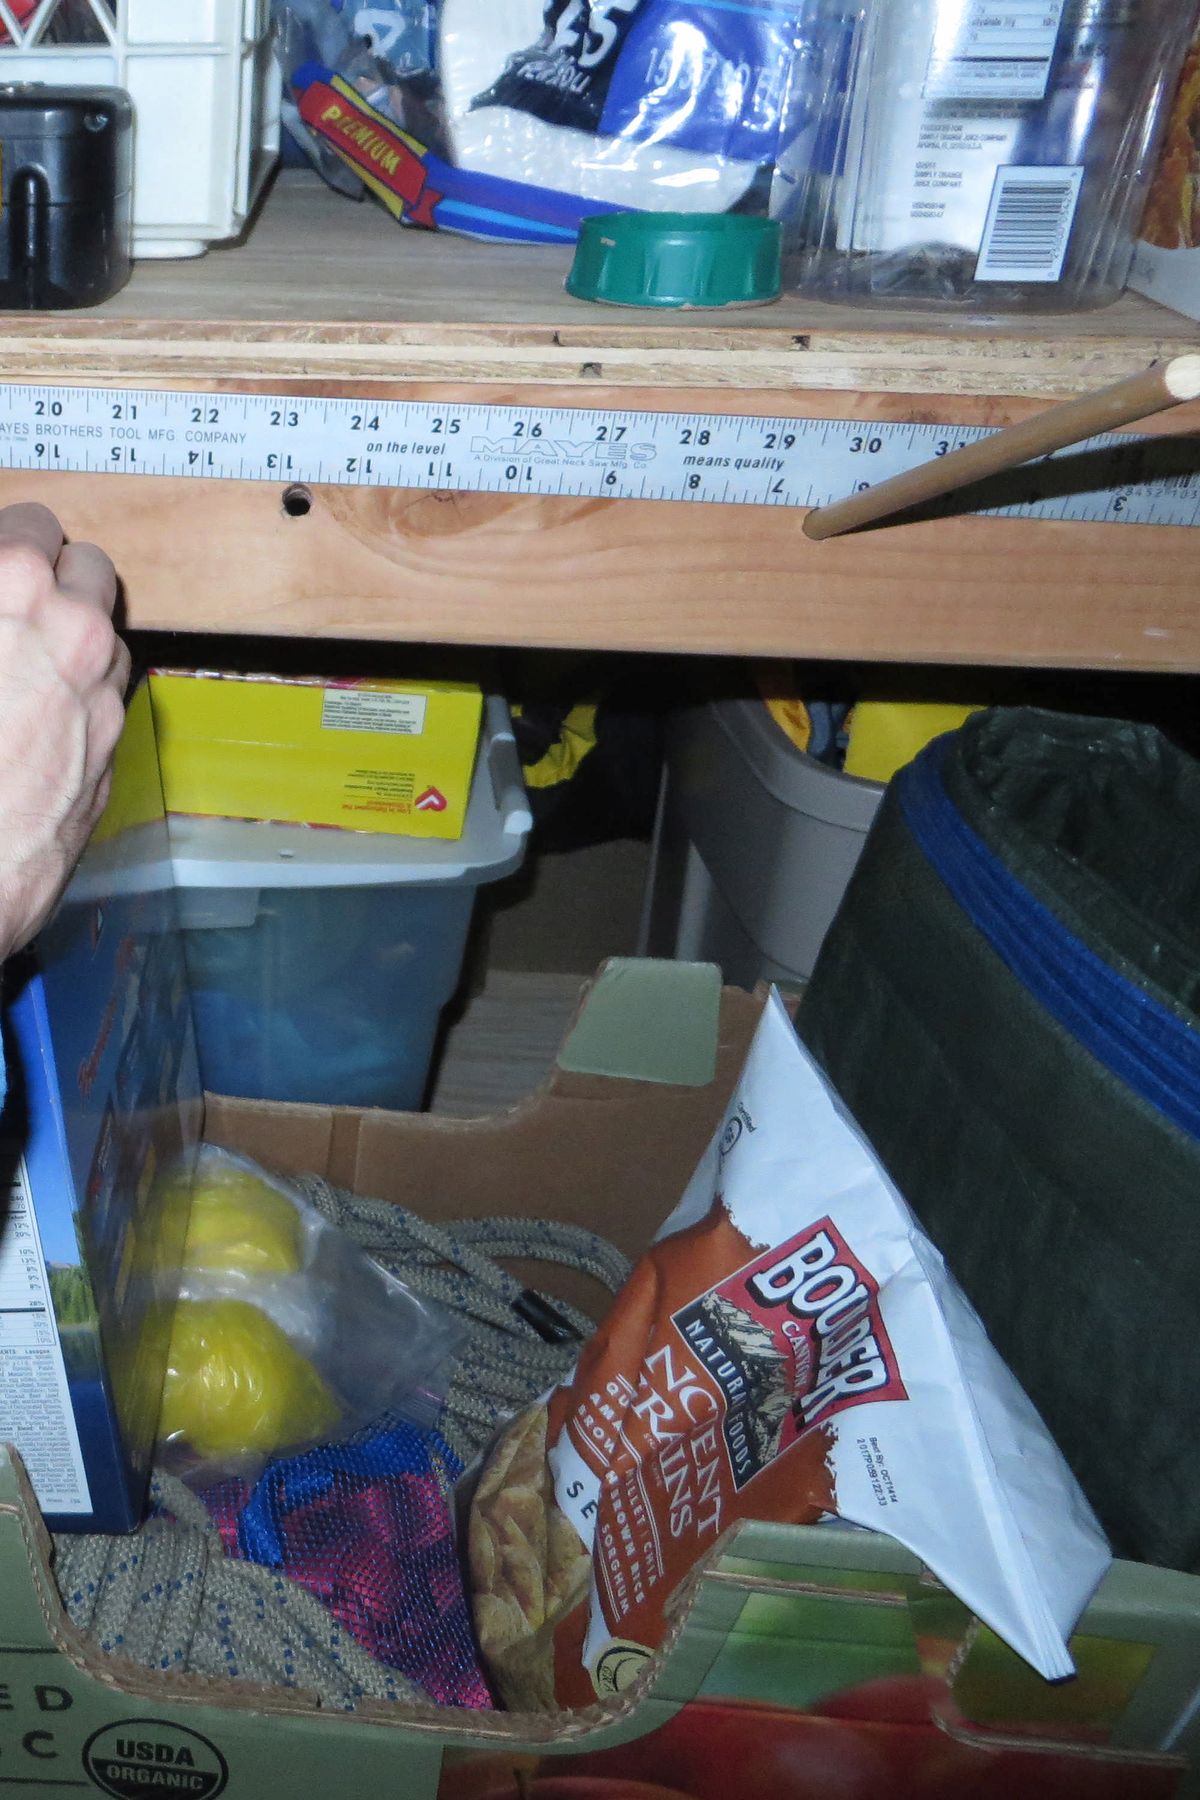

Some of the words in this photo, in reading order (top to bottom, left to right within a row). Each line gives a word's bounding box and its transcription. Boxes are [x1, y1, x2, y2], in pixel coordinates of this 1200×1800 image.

[34, 400, 64, 418] 20
[111, 404, 139, 421] 21
[191, 406, 220, 424] 22
[269, 410, 300, 428] 23
[350, 414, 381, 432] 24
[431, 417, 462, 435] 25
[513, 420, 543, 439] 26
[595, 424, 628, 442] 27
[679, 428, 711, 446] 28
[763, 433, 796, 451] 29
[849, 436, 883, 454] 30
[34, 424, 103, 439] BROTHERS
[109, 426, 142, 441] TOOL
[147, 428, 176, 442] MFG
[184, 430, 248, 445] COMPANY
[34, 442, 60, 460] 16
[111, 446, 137, 463] 15
[188, 449, 216, 467] 14
[365, 441, 383, 454] on
[386, 441, 409, 454] the
[411, 442, 447, 456] level
[470, 435, 659, 461] MAYES
[266, 453, 295, 471] 13
[345, 457, 373, 475] 12
[428, 461, 452, 478] 11
[474, 454, 482, 462] A
[482, 454, 521, 464] Division
[522, 456, 532, 465] of
[534, 457, 561, 467] Great
[562, 458, 587, 468] Neck
[588, 459, 610, 469] Saw
[682, 453, 732, 469] means
[734, 455, 786, 474] quality
[504, 463, 533, 482] 10
[605, 469, 617, 486] 9
[688, 473, 701, 490] 8
[770, 477, 785, 494] 7
[1112, 495, 1128, 512] 3
[750, 1230, 889, 1426] BOULDER
[780, 1319, 812, 1388] CANYON
[644, 1343, 721, 1539] NCIENT
[729, 1411, 752, 1475] FOODS
[869, 1436, 882, 1453] Best
[631, 1371, 693, 1538] RAINS
[875, 1454, 885, 1468] By:
[565, 1479, 600, 1520] SE
[610, 1487, 636, 1558] BROWN
[630, 1560, 645, 1605] RICE
[601, 1523, 630, 1616] SORGHUM
[643, 1541, 658, 1587] CHIA
[114, 1737, 197, 1767] USDA
[105, 1763, 204, 1792] ORGANIC
